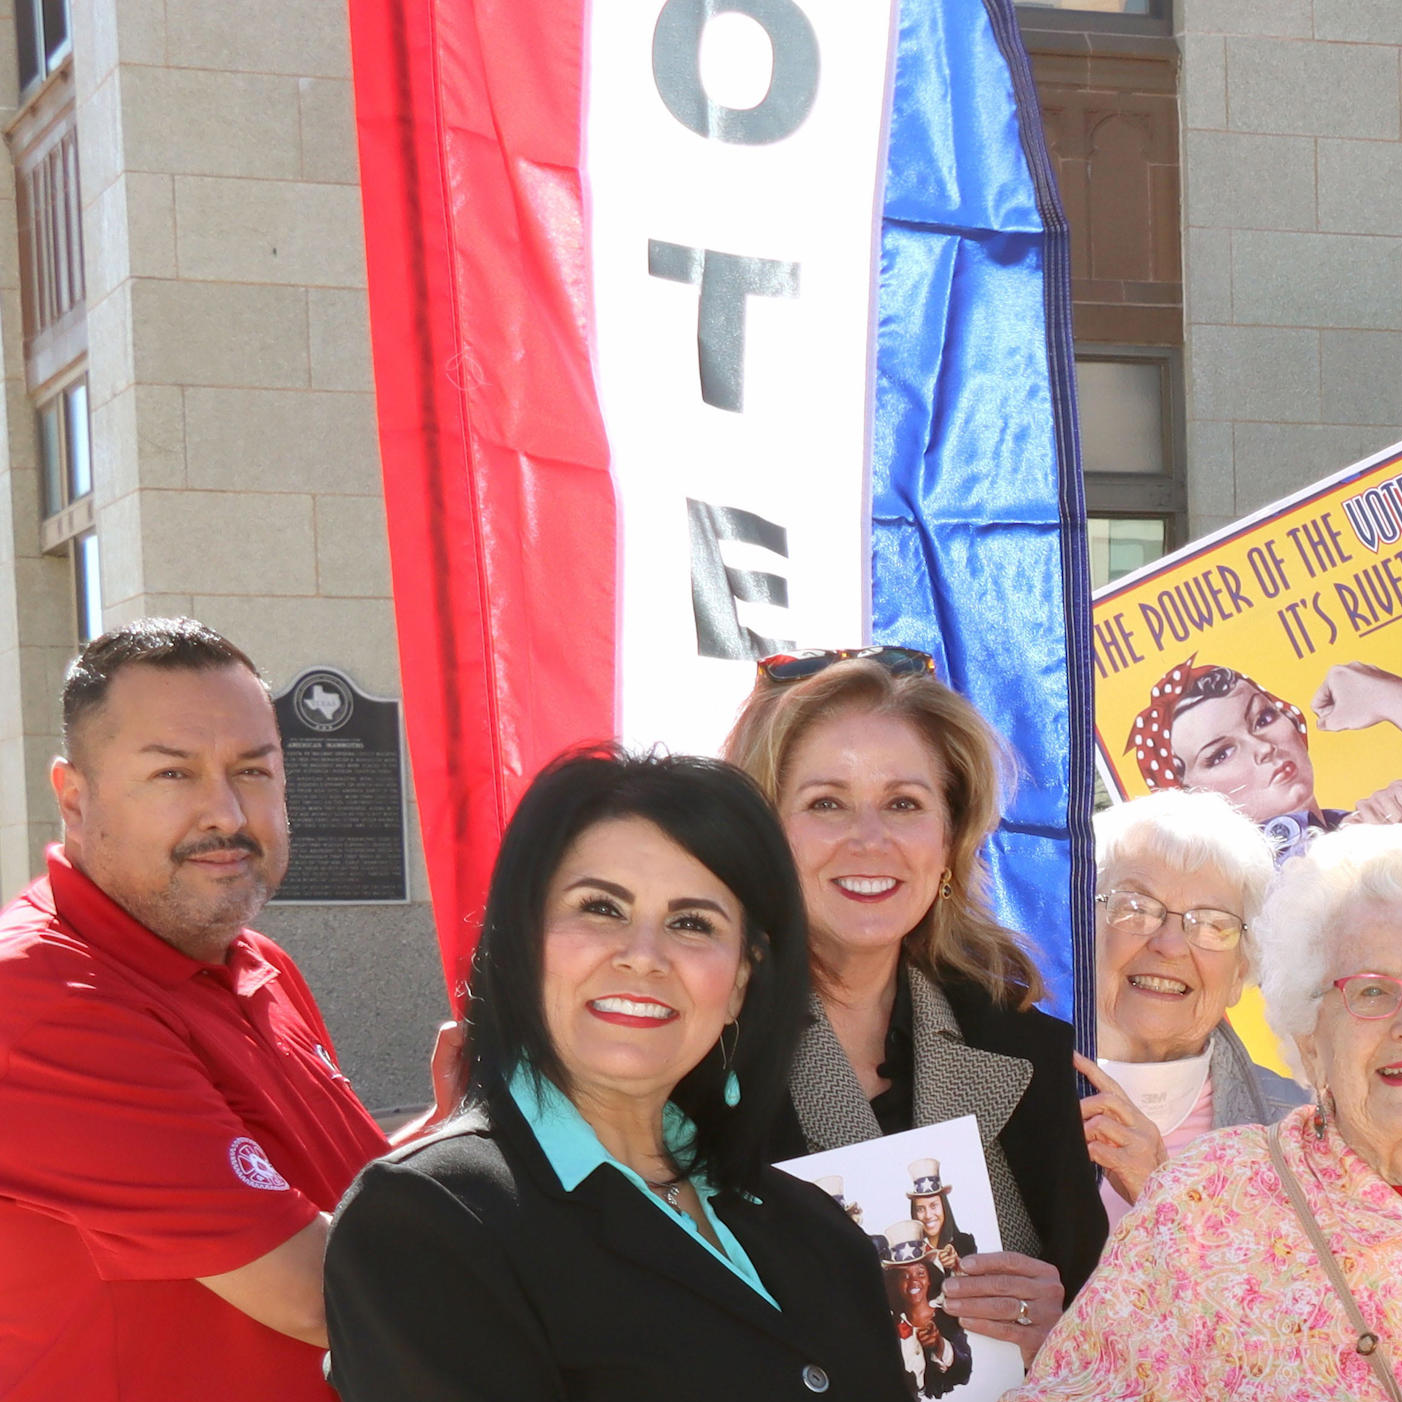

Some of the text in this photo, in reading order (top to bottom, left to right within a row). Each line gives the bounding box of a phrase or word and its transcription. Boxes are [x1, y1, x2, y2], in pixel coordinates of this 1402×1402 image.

[648, 0, 821, 661] OTE
[1138, 565, 1254, 652] POWER
[1247, 539, 1291, 599] OF
[1286, 512, 1353, 578] THE
[1277, 591, 1338, 660] IT'S
